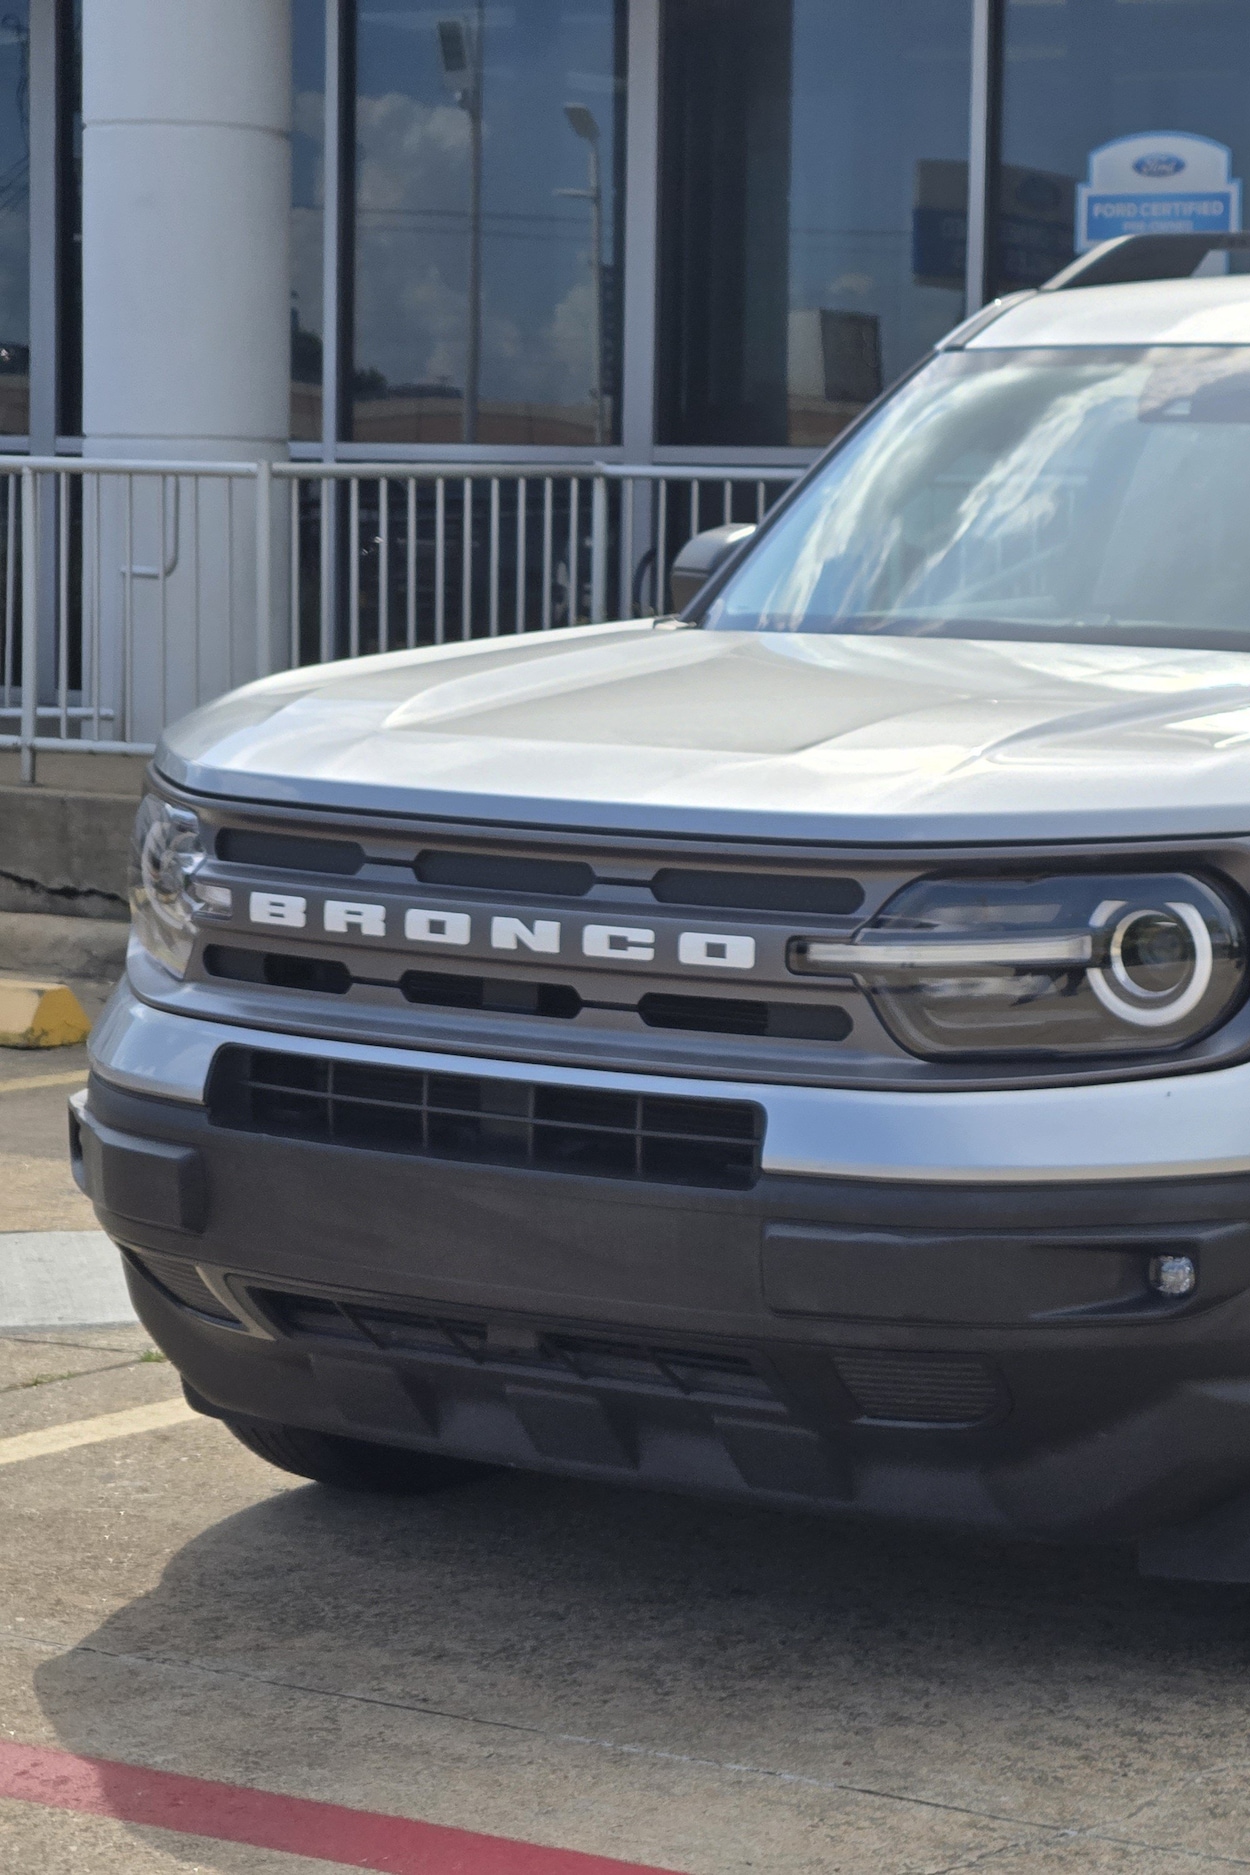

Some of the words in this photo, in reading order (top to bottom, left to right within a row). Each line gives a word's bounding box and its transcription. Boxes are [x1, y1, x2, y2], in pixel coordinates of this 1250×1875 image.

[1093, 202, 1138, 218] FORD
[1139, 200, 1225, 217] CERTIFIED
[248, 890, 756, 970] BRONCO
